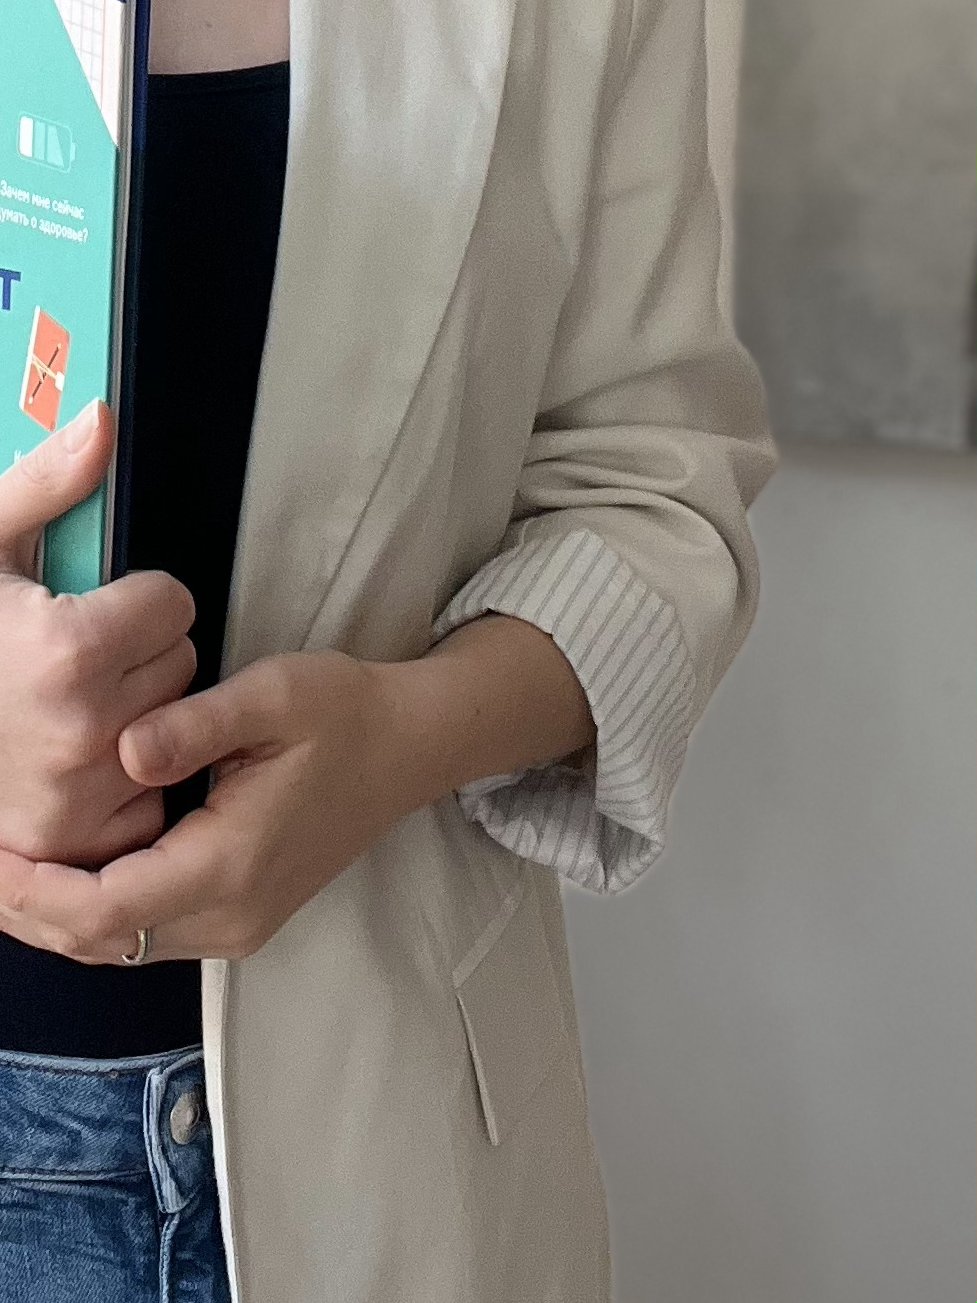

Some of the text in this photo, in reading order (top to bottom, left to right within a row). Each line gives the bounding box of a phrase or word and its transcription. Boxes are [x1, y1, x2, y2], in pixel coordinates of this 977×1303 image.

[0, 179, 85, 220] Зачем мне сейчас
[31, 216, 38, 229] о
[39, 218, 89, 244] здоровье?
